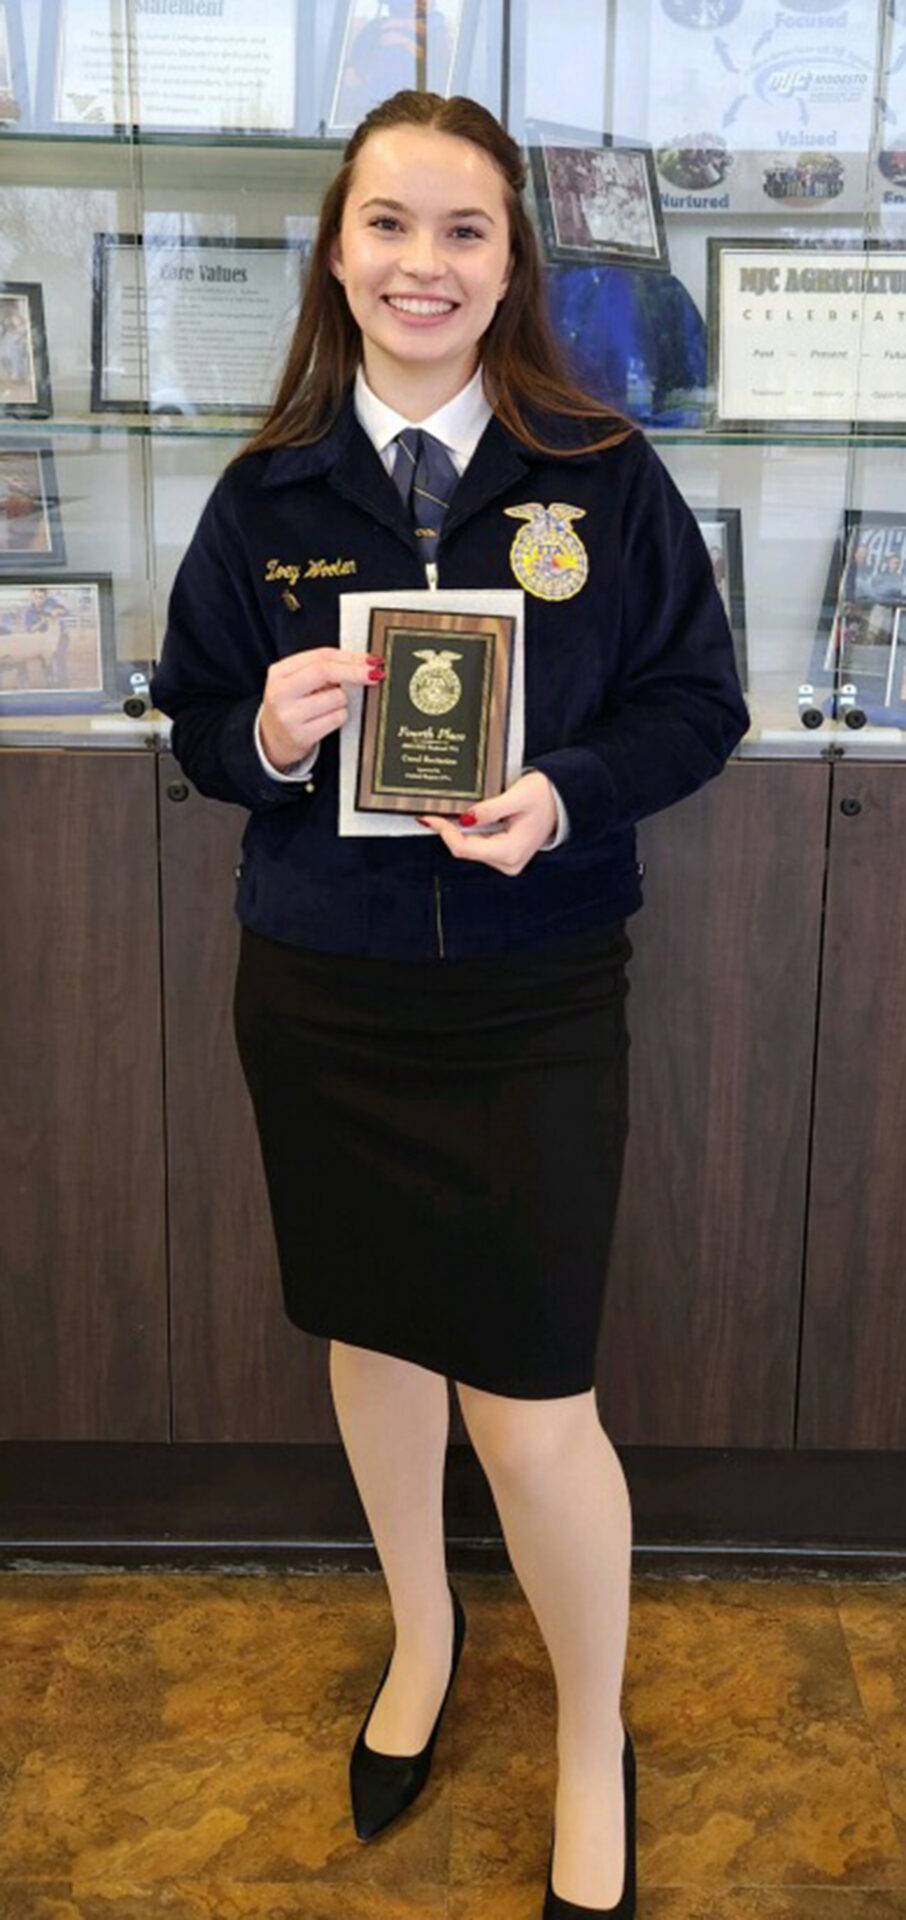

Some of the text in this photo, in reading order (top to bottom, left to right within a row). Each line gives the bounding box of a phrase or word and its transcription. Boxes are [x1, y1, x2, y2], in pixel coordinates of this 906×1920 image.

[775, 13, 847, 28] Focused
[777, 131, 838, 147] Valued
[659, 193, 730, 209] Nurtured
[160, 264, 248, 283] Core Values
[740, 268, 779, 295] MJC
[752, 349, 774, 358] Past
[810, 350, 849, 359] Present
[397, 725, 466, 742] Fourth Place
